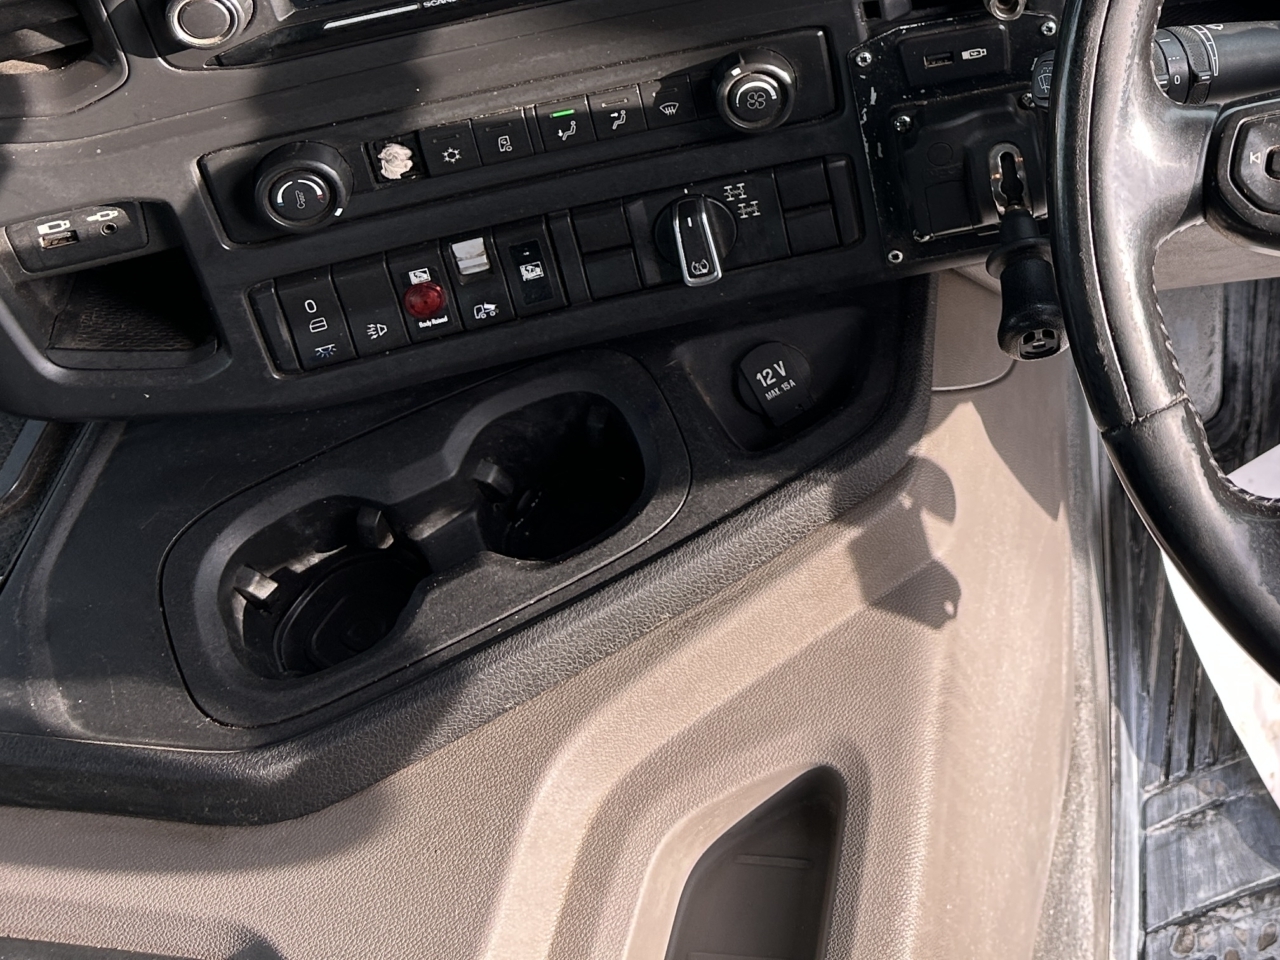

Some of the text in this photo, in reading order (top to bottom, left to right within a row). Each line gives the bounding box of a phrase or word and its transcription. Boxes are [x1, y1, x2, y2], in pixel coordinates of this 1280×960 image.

[304, 298, 317, 314] 0
[756, 360, 787, 388] 12 V
